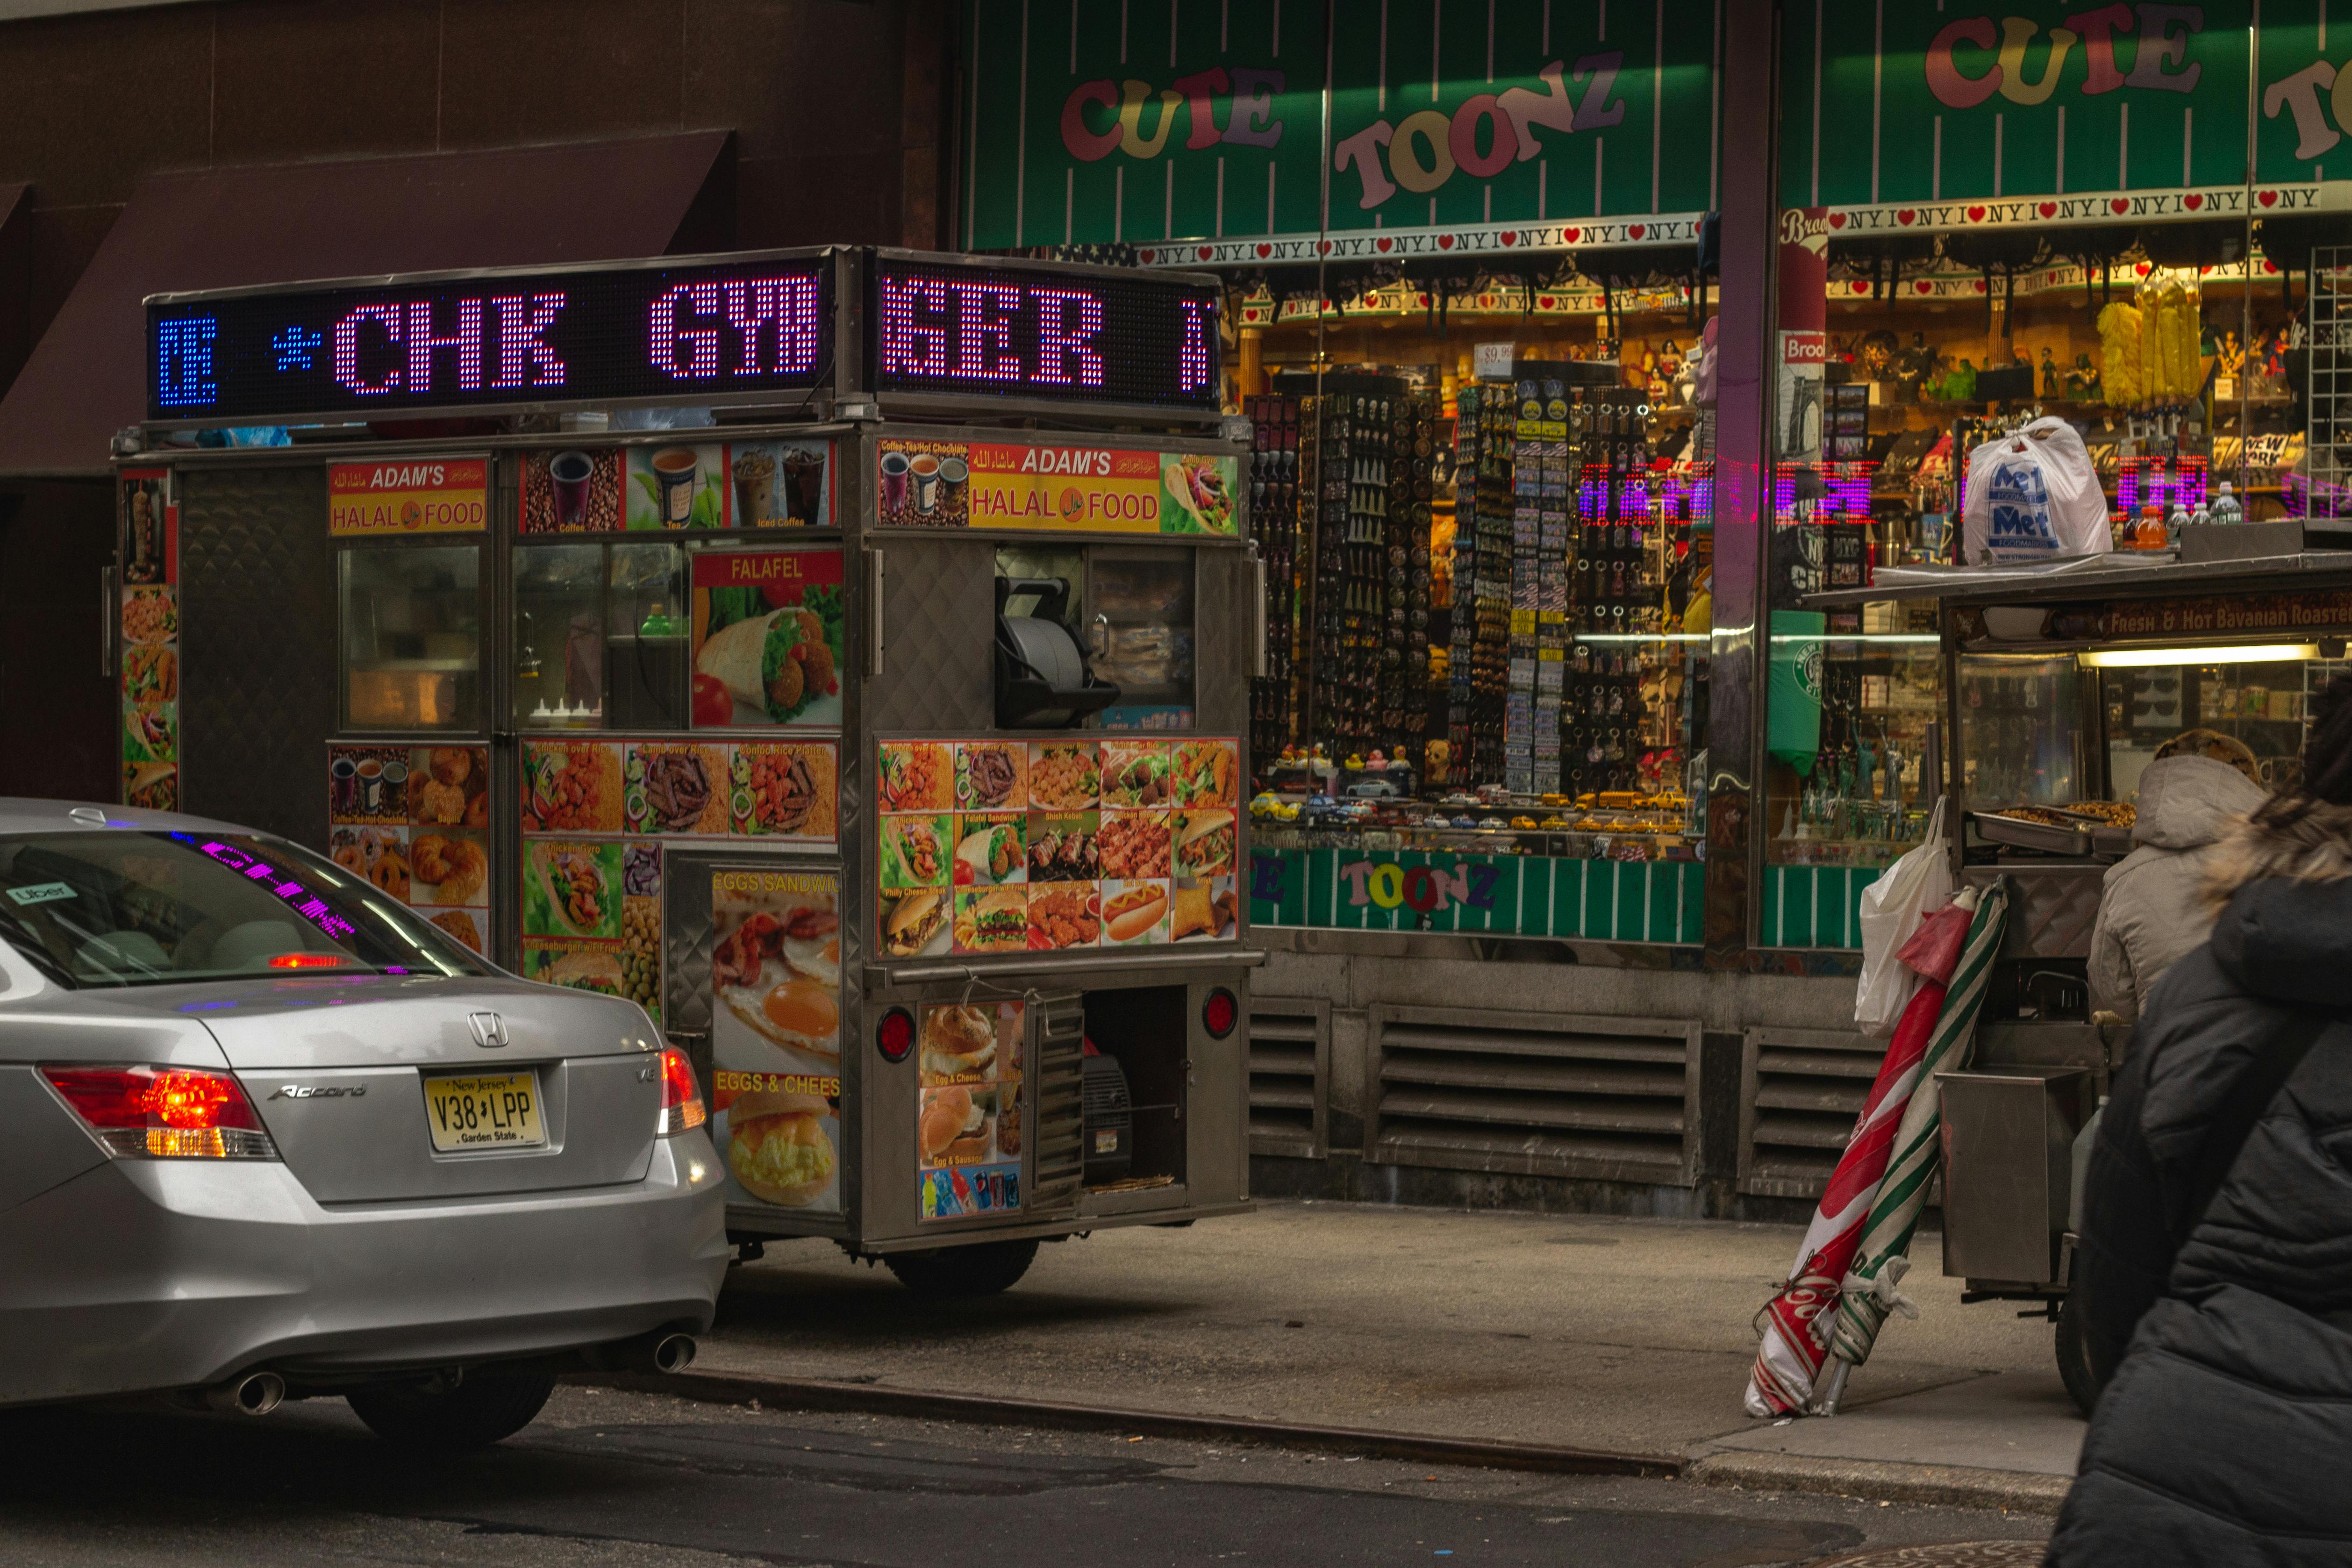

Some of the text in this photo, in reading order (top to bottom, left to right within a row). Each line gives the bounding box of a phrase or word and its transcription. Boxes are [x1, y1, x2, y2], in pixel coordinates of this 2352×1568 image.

[1925, 2, 2204, 108] CUTE
[1061, 50, 1626, 209] CUTE TOONZ
[336, 293, 565, 395] CHK
[933, 442, 968, 453] Chocolate
[1021, 448, 1111, 476] ADAM'S
[371, 465, 445, 489] ADAM'S
[972, 488, 1158, 521] HALAL FOOD
[333, 502, 484, 529] HALAL FOOD
[758, 517, 805, 527] Iced Coffee
[1994, 506, 2049, 537] Met
[559, 523, 586, 532] Coffee
[666, 521, 681, 530] Tea
[732, 557, 803, 579] FALAFEL
[2163, 610, 2176, 631] &
[535, 742, 611, 753] Chicken over Rice
[643, 743, 710, 754] Lamb over Rice
[739, 744, 826, 755] Combo Rice Platter
[888, 743, 913, 752] Chicken
[930, 743, 944, 751] Rice
[438, 814, 461, 825] Bagels
[965, 813, 1017, 823] Falafel Sandwich
[1045, 811, 1083, 821] Shish Kebab
[545, 841, 601, 857] Chicken Gyro
[713, 872, 759, 892] EGGS
[1196, 877, 1212, 885] Knish
[1340, 859, 1501, 912] TOONZ
[15, 888, 65, 900] Uber
[885, 886, 946, 898] Philly Cheese Steak
[524, 939, 581, 954] Cheeseburger
[636, 1069, 655, 1083] V6
[716, 1072, 763, 1093] EGGS
[768, 1074, 779, 1094] &
[936, 1072, 981, 1085] Egg & Cheese
[267, 1083, 367, 1101] Accord
[452, 1078, 508, 1093] New Jersey
[435, 1092, 530, 1131] V38 LPP
[461, 1131, 517, 1144] Garden State
[934, 1154, 983, 1167] Egg & Sausage
